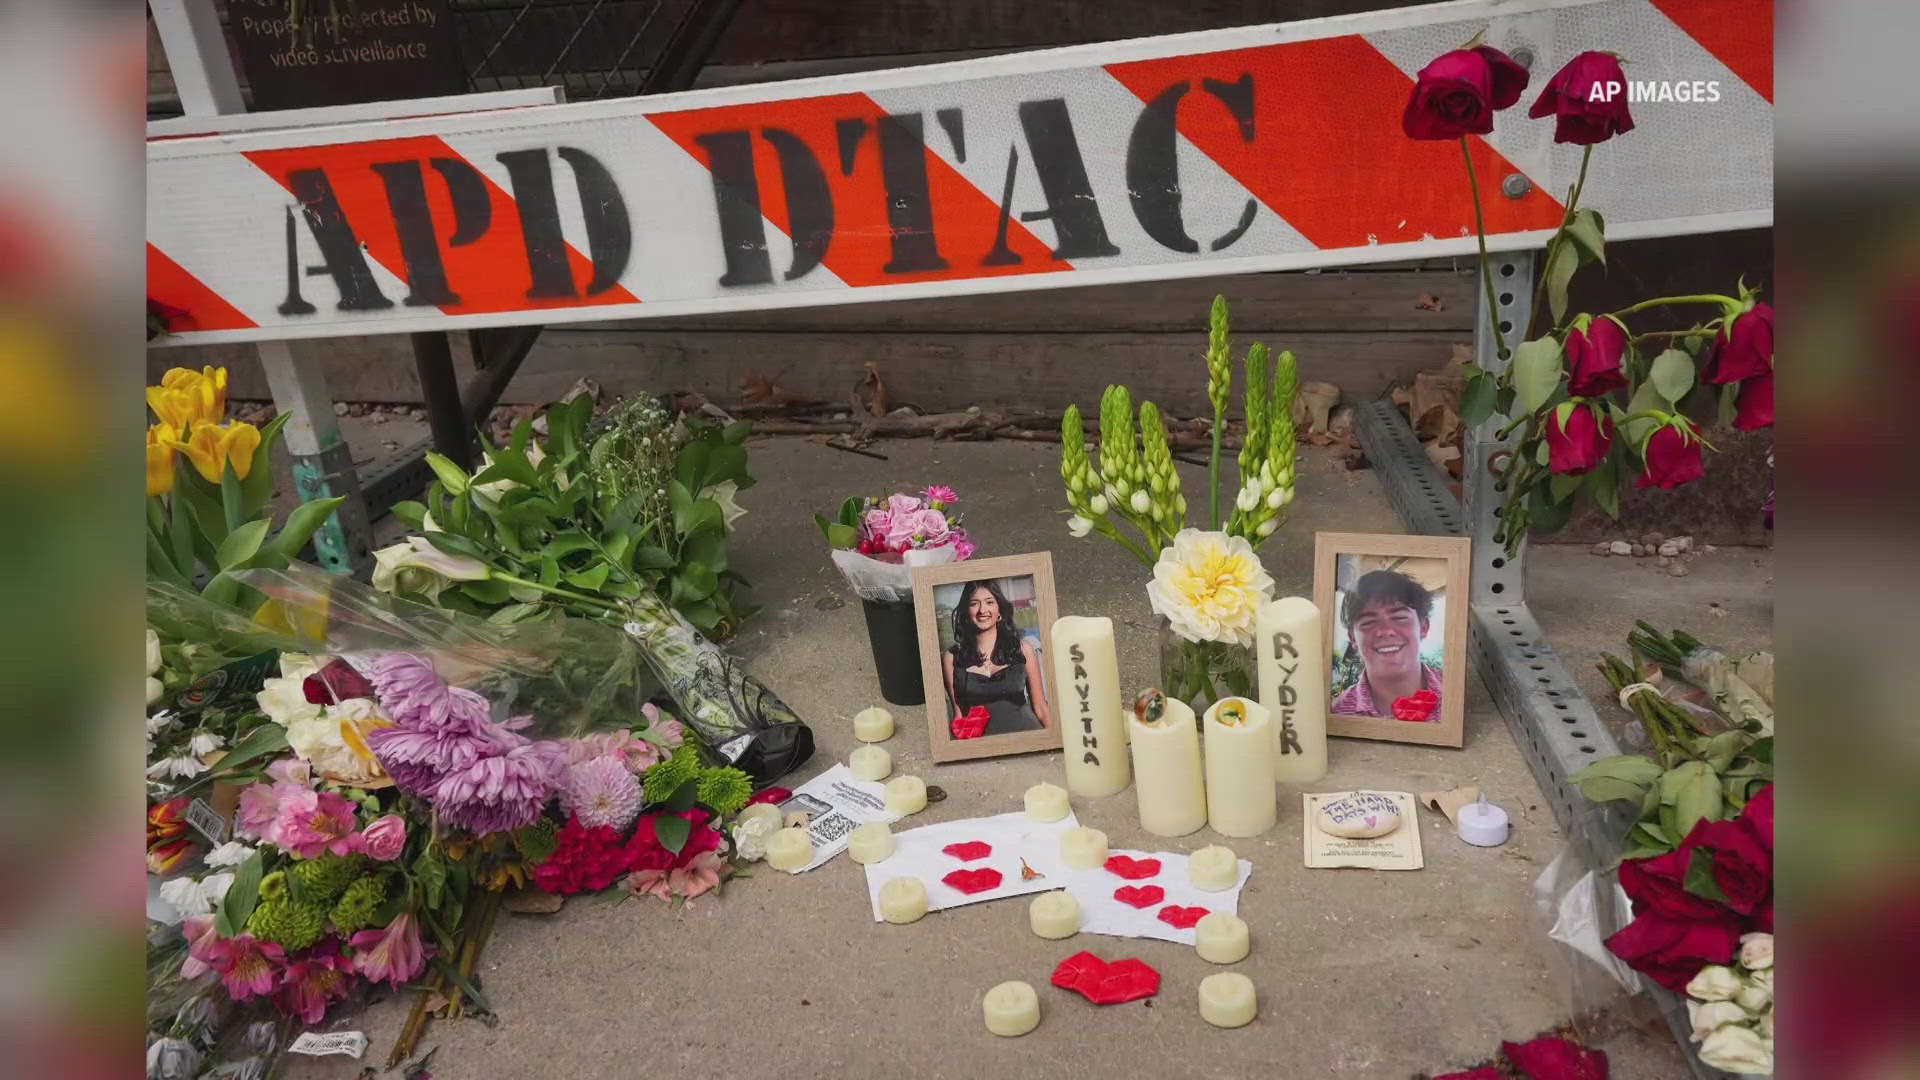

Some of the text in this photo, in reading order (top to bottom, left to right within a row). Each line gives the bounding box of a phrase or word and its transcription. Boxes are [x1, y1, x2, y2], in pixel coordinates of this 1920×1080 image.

[242, 1, 438, 39] Prope poected by
[270, 40, 428, 68] video surveillance
[277, 71, 1258, 316] APD DTAC
[1069, 643, 1100, 767] SAVITHA
[1273, 632, 1303, 756] RYDER
[1325, 802, 1353, 816] THE
[1356, 796, 1393, 806] HARD
[1333, 803, 1400, 824] DAYS WIN!
